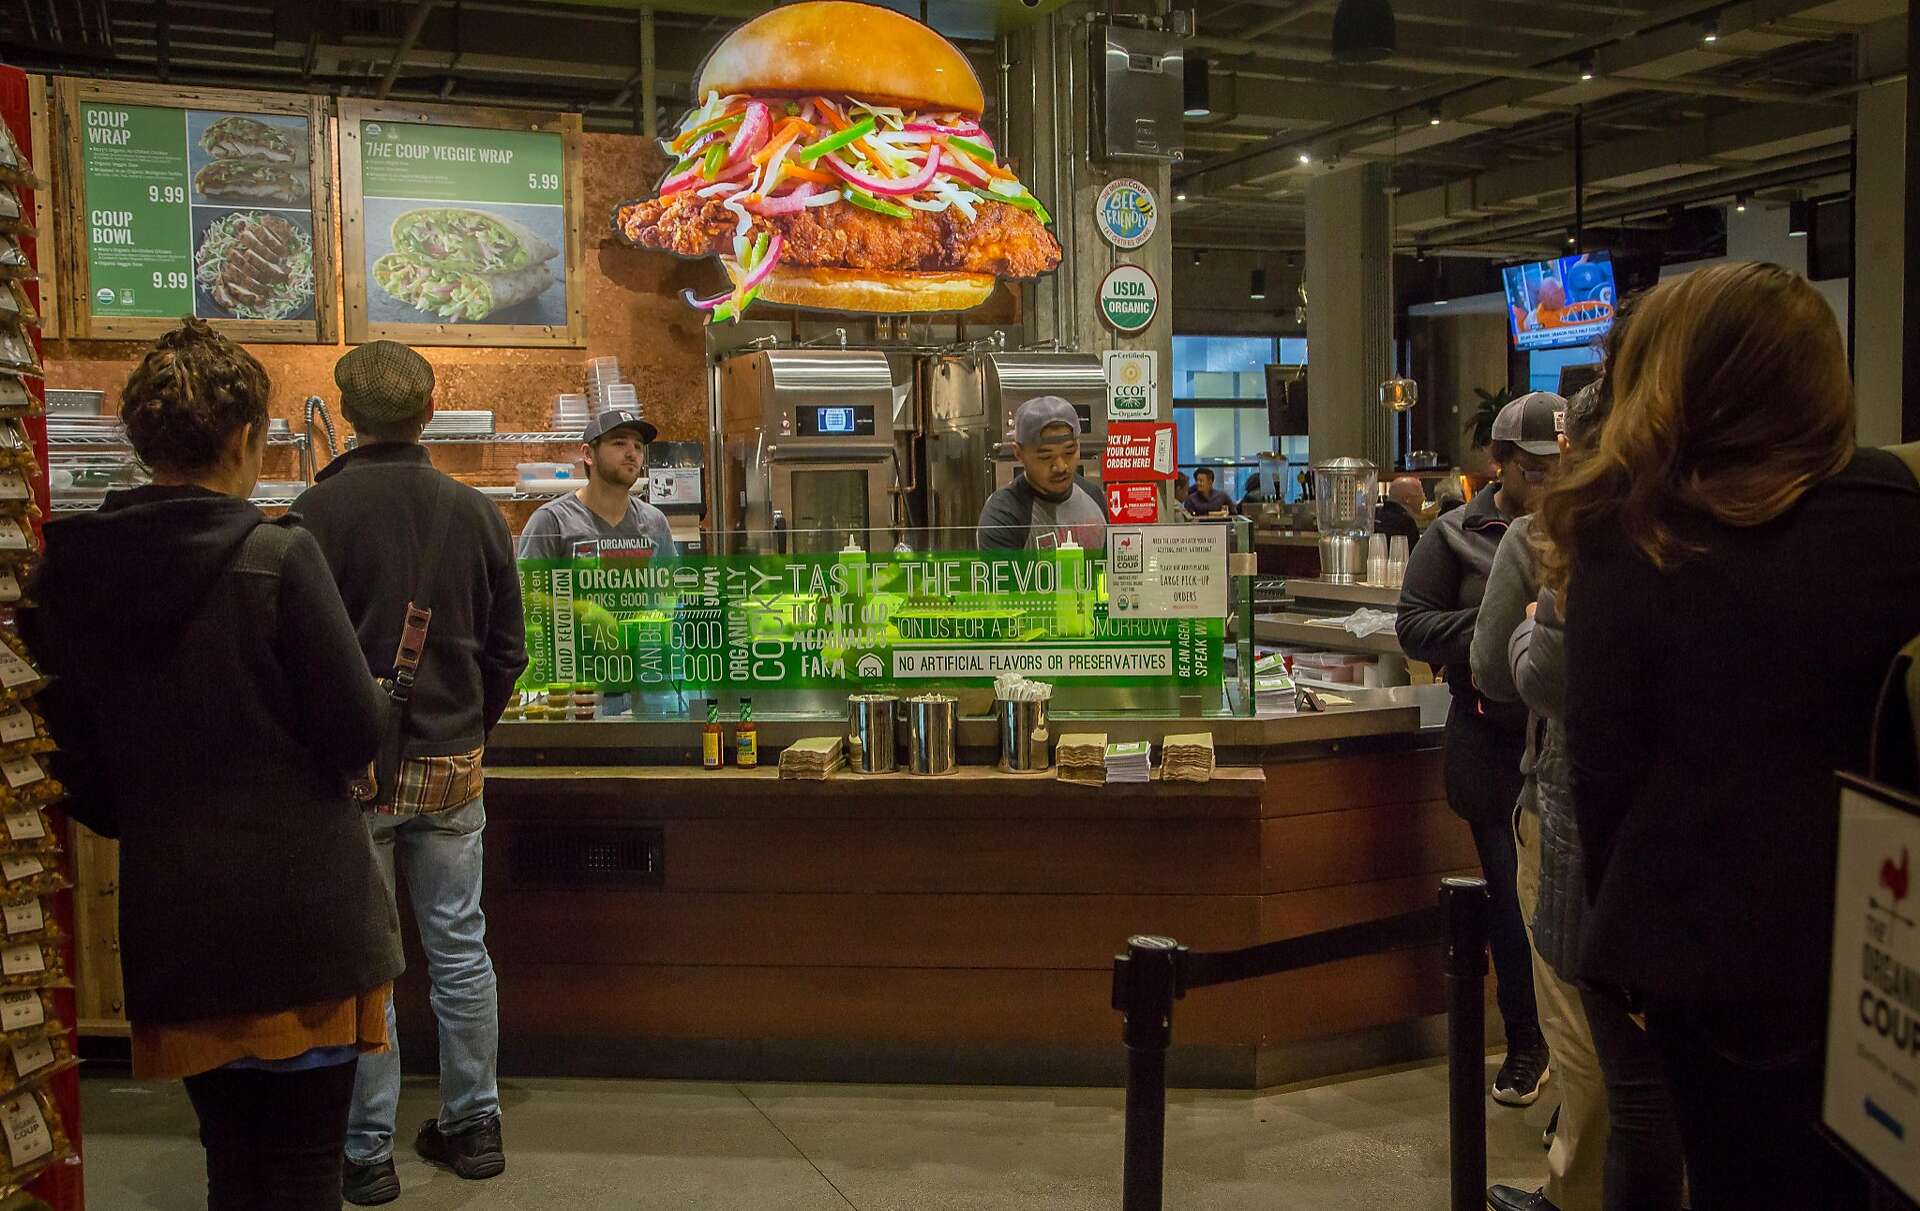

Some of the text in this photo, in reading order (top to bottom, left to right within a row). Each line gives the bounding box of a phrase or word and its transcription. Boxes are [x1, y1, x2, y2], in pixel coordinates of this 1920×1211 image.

[87, 110, 129, 128] COUP
[89, 128, 131, 145] WRAP
[365, 142, 513, 164] THE COUP VEGGIE WRAP
[529, 173, 559, 190] 5.99
[148, 185, 184, 203] 9.99
[1110, 190, 1137, 210] BEE
[92, 210, 133, 227] COUP
[1106, 208, 1148, 230] FRIENDLY
[92, 228, 135, 245] BOWL
[152, 272, 188, 289] 9.99
[1113, 281, 1146, 296] USDA
[1108, 301, 1150, 314] ORGANIC
[1115, 385, 1146, 397] CCOF
[1122, 435, 1132, 445] UP
[1107, 447, 1124, 457] YOUR
[1125, 446, 1150, 457] ONLINE
[1106, 458, 1151, 469] ORDERS HERE!
[579, 567, 670, 590] ORGANIC
[785, 563, 891, 598] TASTE
[899, 561, 961, 597] THE
[1160, 574, 1179, 587] LARGE
[529, 570, 543, 625] Chicken
[620, 592, 649, 607] GOOD
[1173, 591, 1197, 603] ORDERS
[726, 566, 750, 681] ORGANICALLY
[750, 564, 786, 681] COCKY
[930, 617, 950, 638] US
[956, 617, 985, 638] FOR
[991, 617, 1001, 638] A
[581, 622, 633, 651] FAST
[670, 621, 722, 650] GOOD
[1178, 617, 1190, 648] AGEN
[558, 648, 574, 680] FOOD
[640, 647, 663, 683] CAN
[899, 654, 1166, 671] NO ARTIFICIAL FLAVORS OR PRESERVATIVES
[1178, 648, 1190, 664] AN
[1194, 638, 1208, 677] SPEAK
[582, 655, 633, 683] FOOD
[670, 654, 723, 682] FOOD
[801, 655, 846, 680] FARM
[1178, 664, 1191, 678] BE
[14, 1123, 40, 1141] COUP
